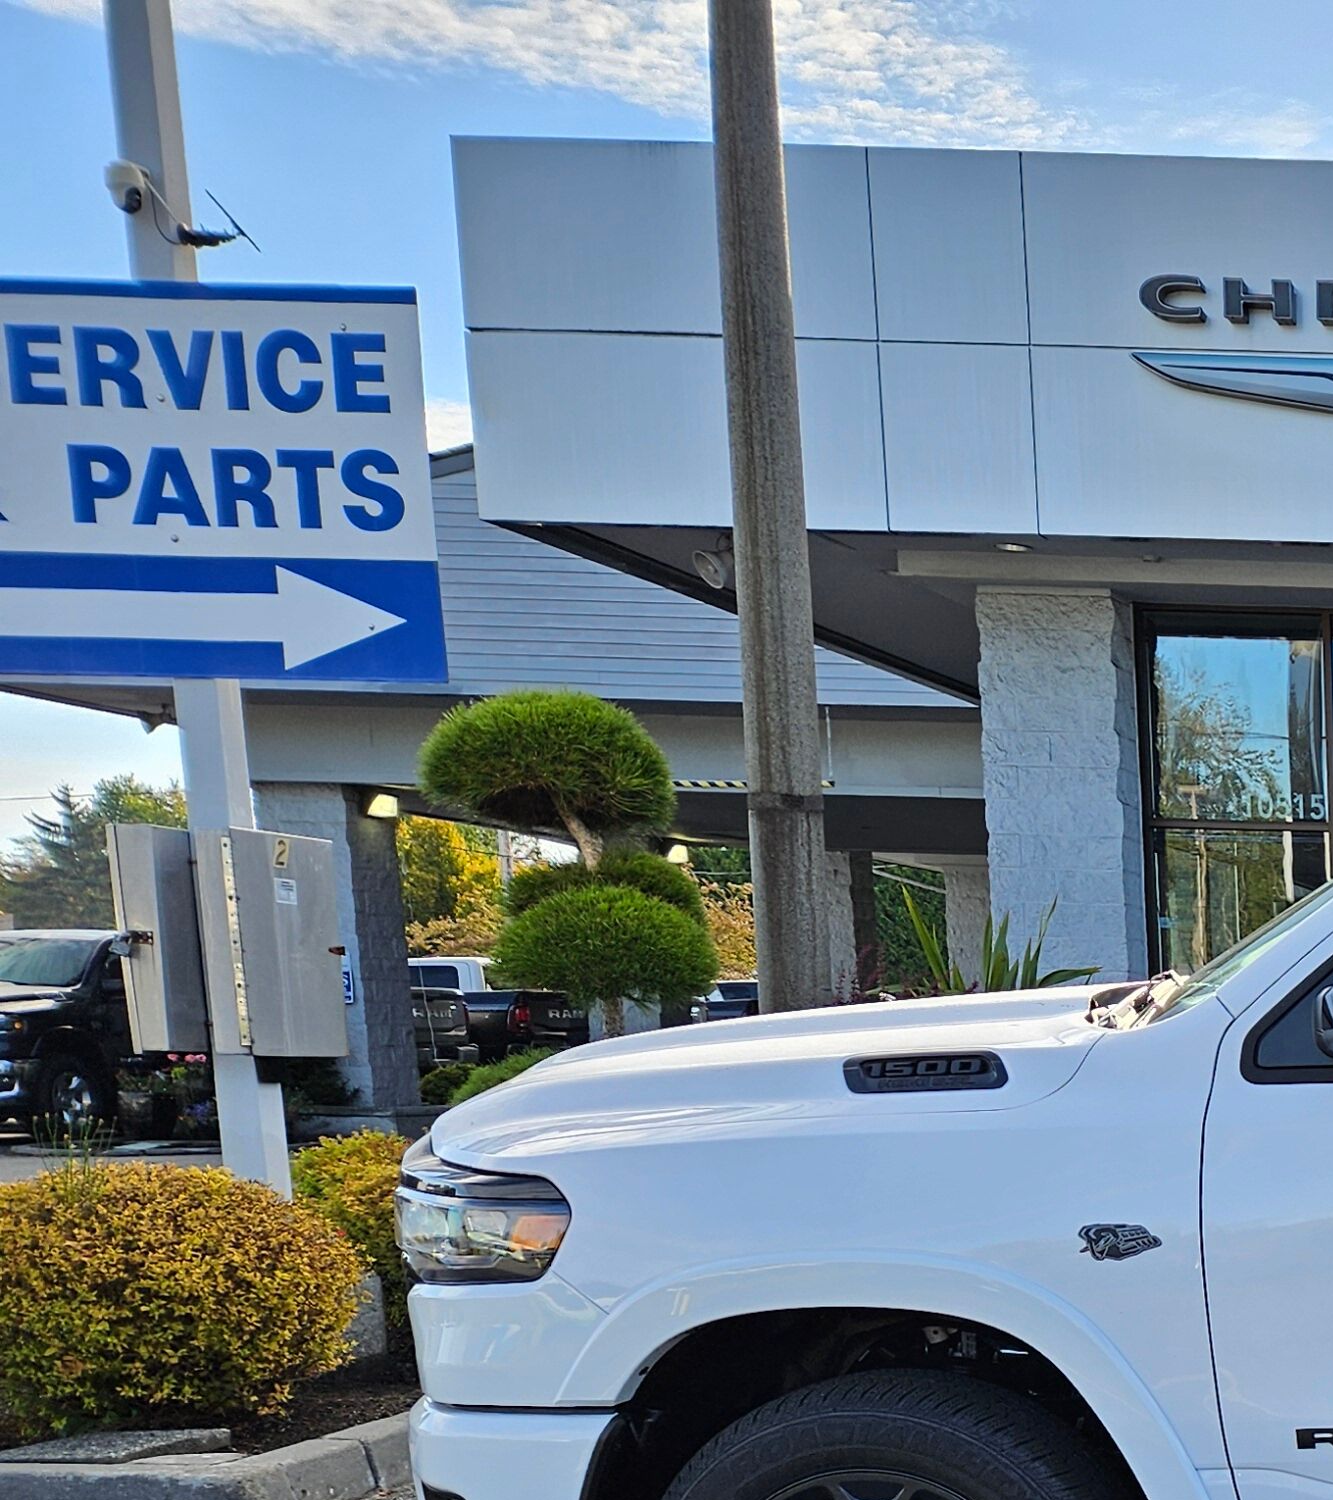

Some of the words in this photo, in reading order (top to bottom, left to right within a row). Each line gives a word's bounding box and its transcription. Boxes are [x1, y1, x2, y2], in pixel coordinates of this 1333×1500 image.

[66, 443, 406, 532] PARTS
[1241, 792, 1325, 820] 10515
[274, 839, 287, 866] 2
[548, 1008, 587, 1019] RAM
[867, 1058, 981, 1077] 1500
